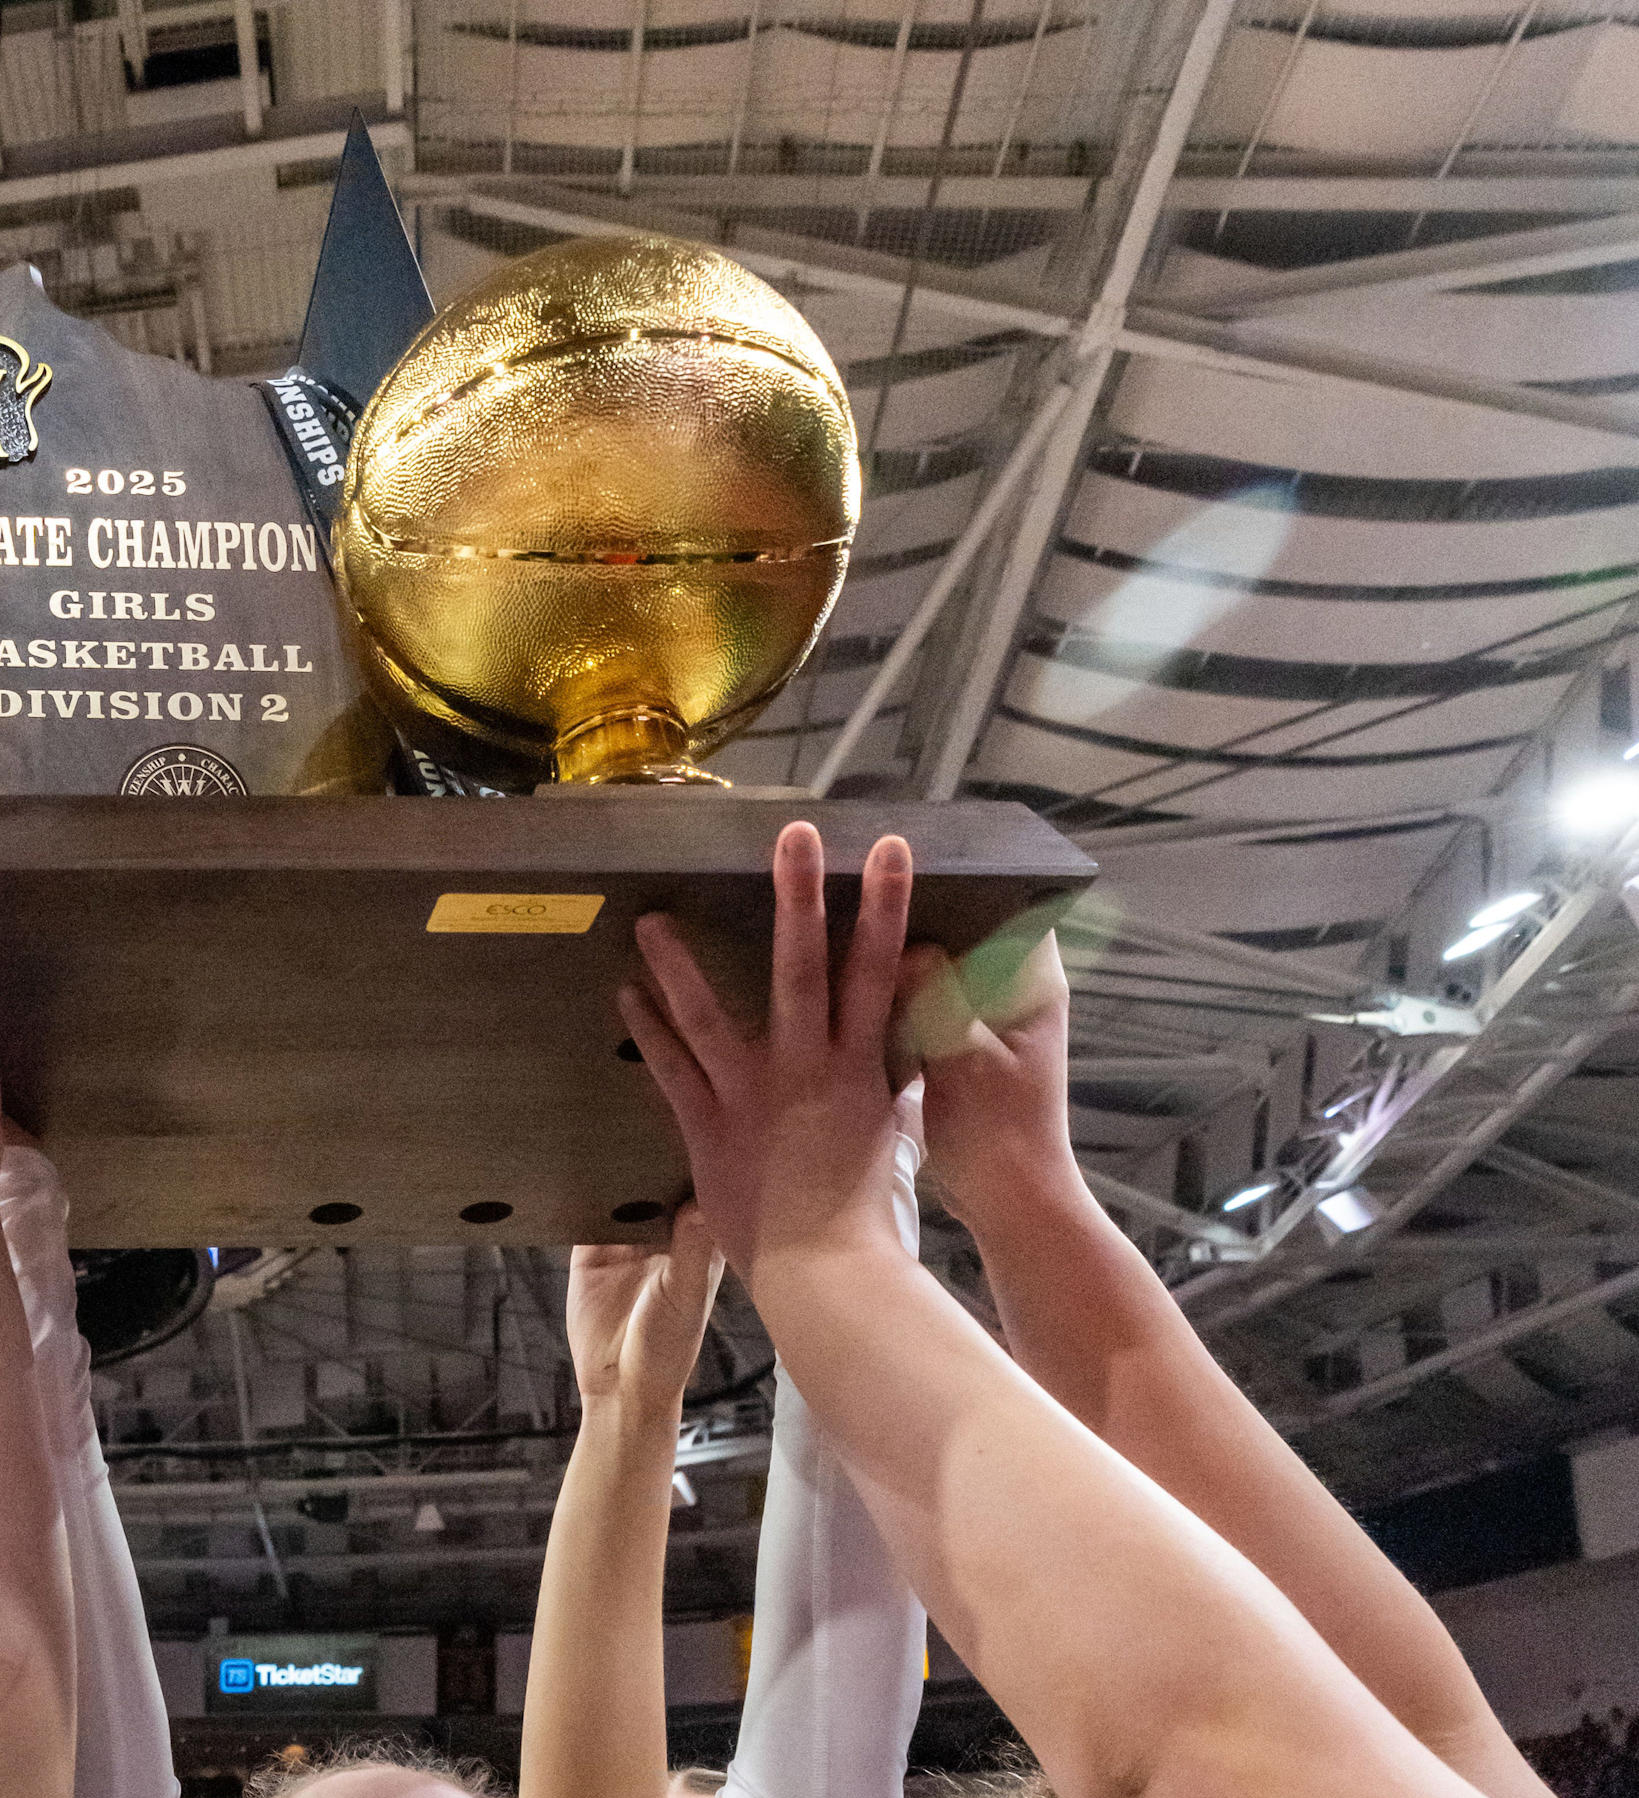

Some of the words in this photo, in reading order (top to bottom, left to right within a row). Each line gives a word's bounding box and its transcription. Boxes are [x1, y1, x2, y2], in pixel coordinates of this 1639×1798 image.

[65, 468, 187, 496] 2025
[87, 518, 317, 573] CHAMPION
[48, 590, 216, 622] GIRLS
[260, 694, 290, 723] 2
[128, 756, 166, 796] IZENSHIP
[200, 758, 240, 796] CHARAC
[255, 1663, 364, 1687] TicketStar
